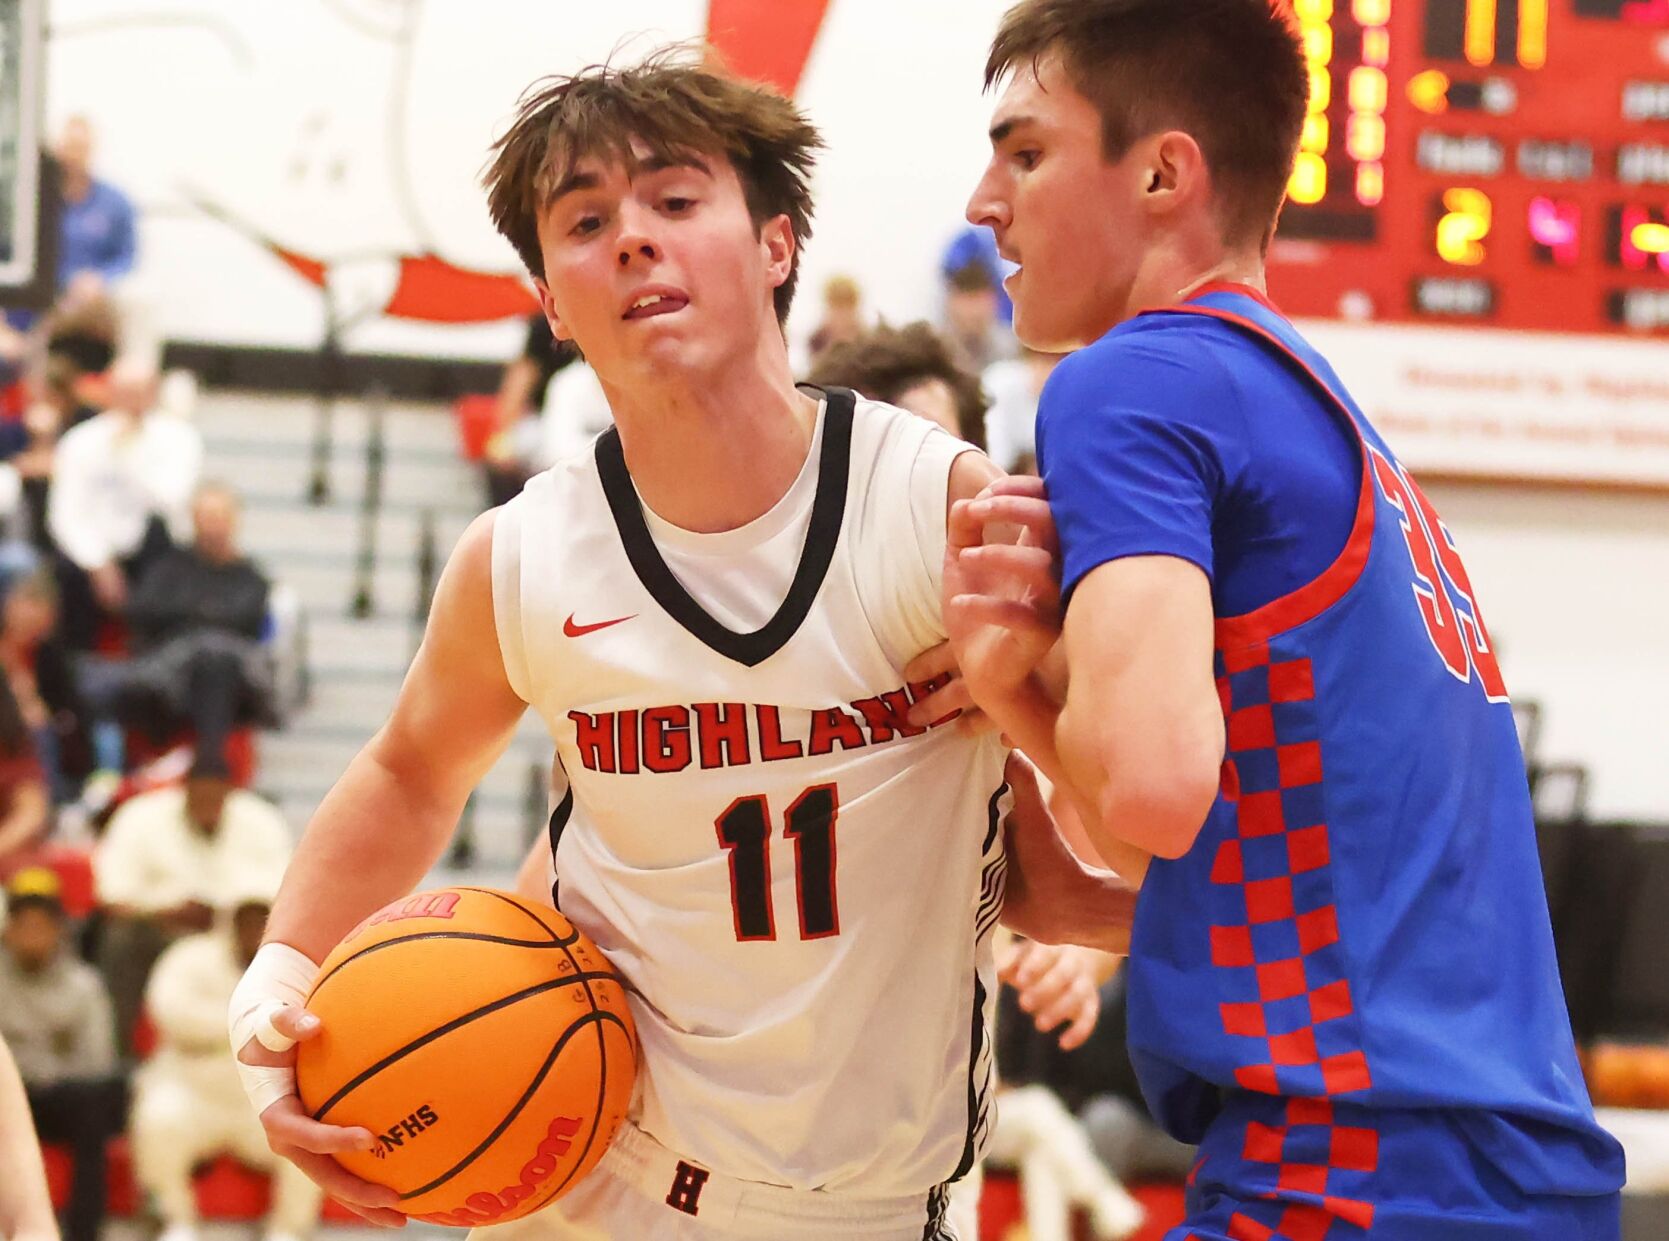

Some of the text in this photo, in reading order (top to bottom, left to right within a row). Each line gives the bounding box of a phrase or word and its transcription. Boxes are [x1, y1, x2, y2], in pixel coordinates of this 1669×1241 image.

[713, 782, 841, 942] 11
[377, 1104, 439, 1153] NFHS
[665, 1159, 710, 1217] H
